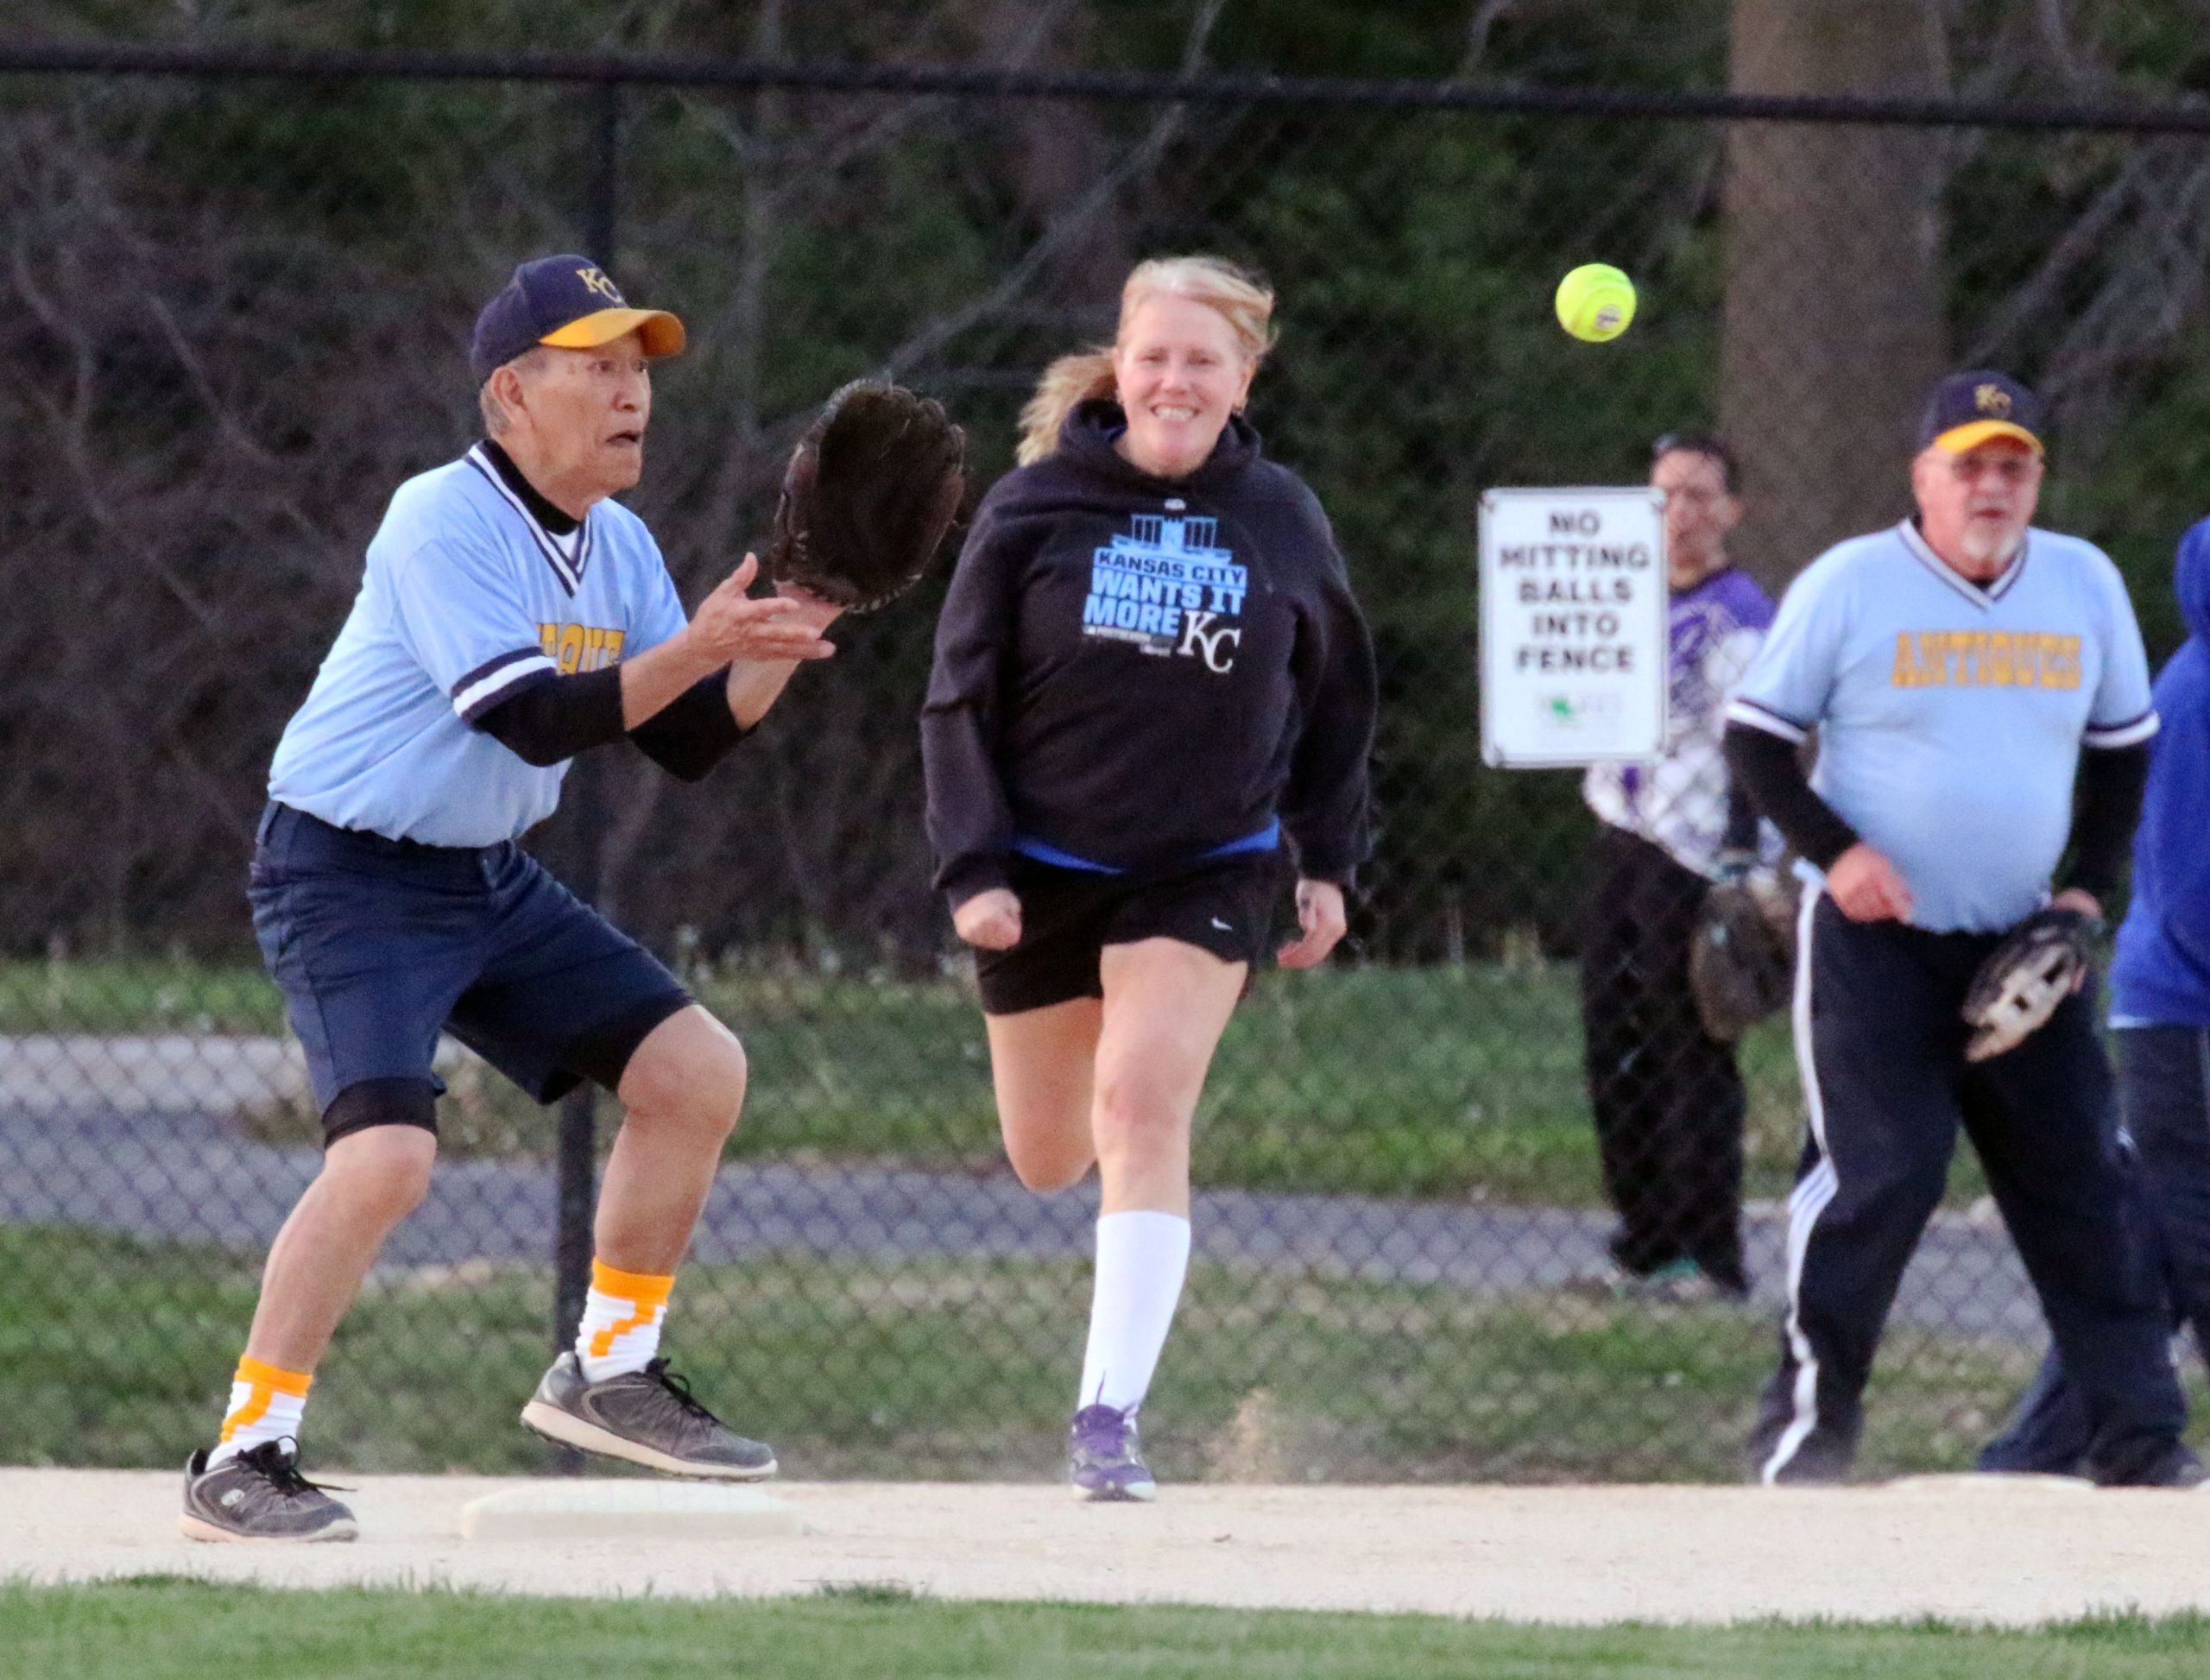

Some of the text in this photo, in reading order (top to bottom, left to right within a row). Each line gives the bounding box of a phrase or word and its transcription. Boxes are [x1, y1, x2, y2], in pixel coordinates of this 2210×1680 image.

[576, 268, 622, 303] KC
[1550, 513, 1601, 534] NO
[1098, 550, 1244, 584] KANSAS CITY
[1500, 546, 1649, 568] HITTING
[1092, 567, 1246, 615] WANTS IT
[1519, 580, 1631, 603] BALLS
[1083, 594, 1179, 635] MORE
[1532, 612, 1620, 637] INTO
[1177, 609, 1241, 673] KC
[1518, 649, 1632, 672] FENCE
[1894, 633, 2081, 687] ANTIQUES
